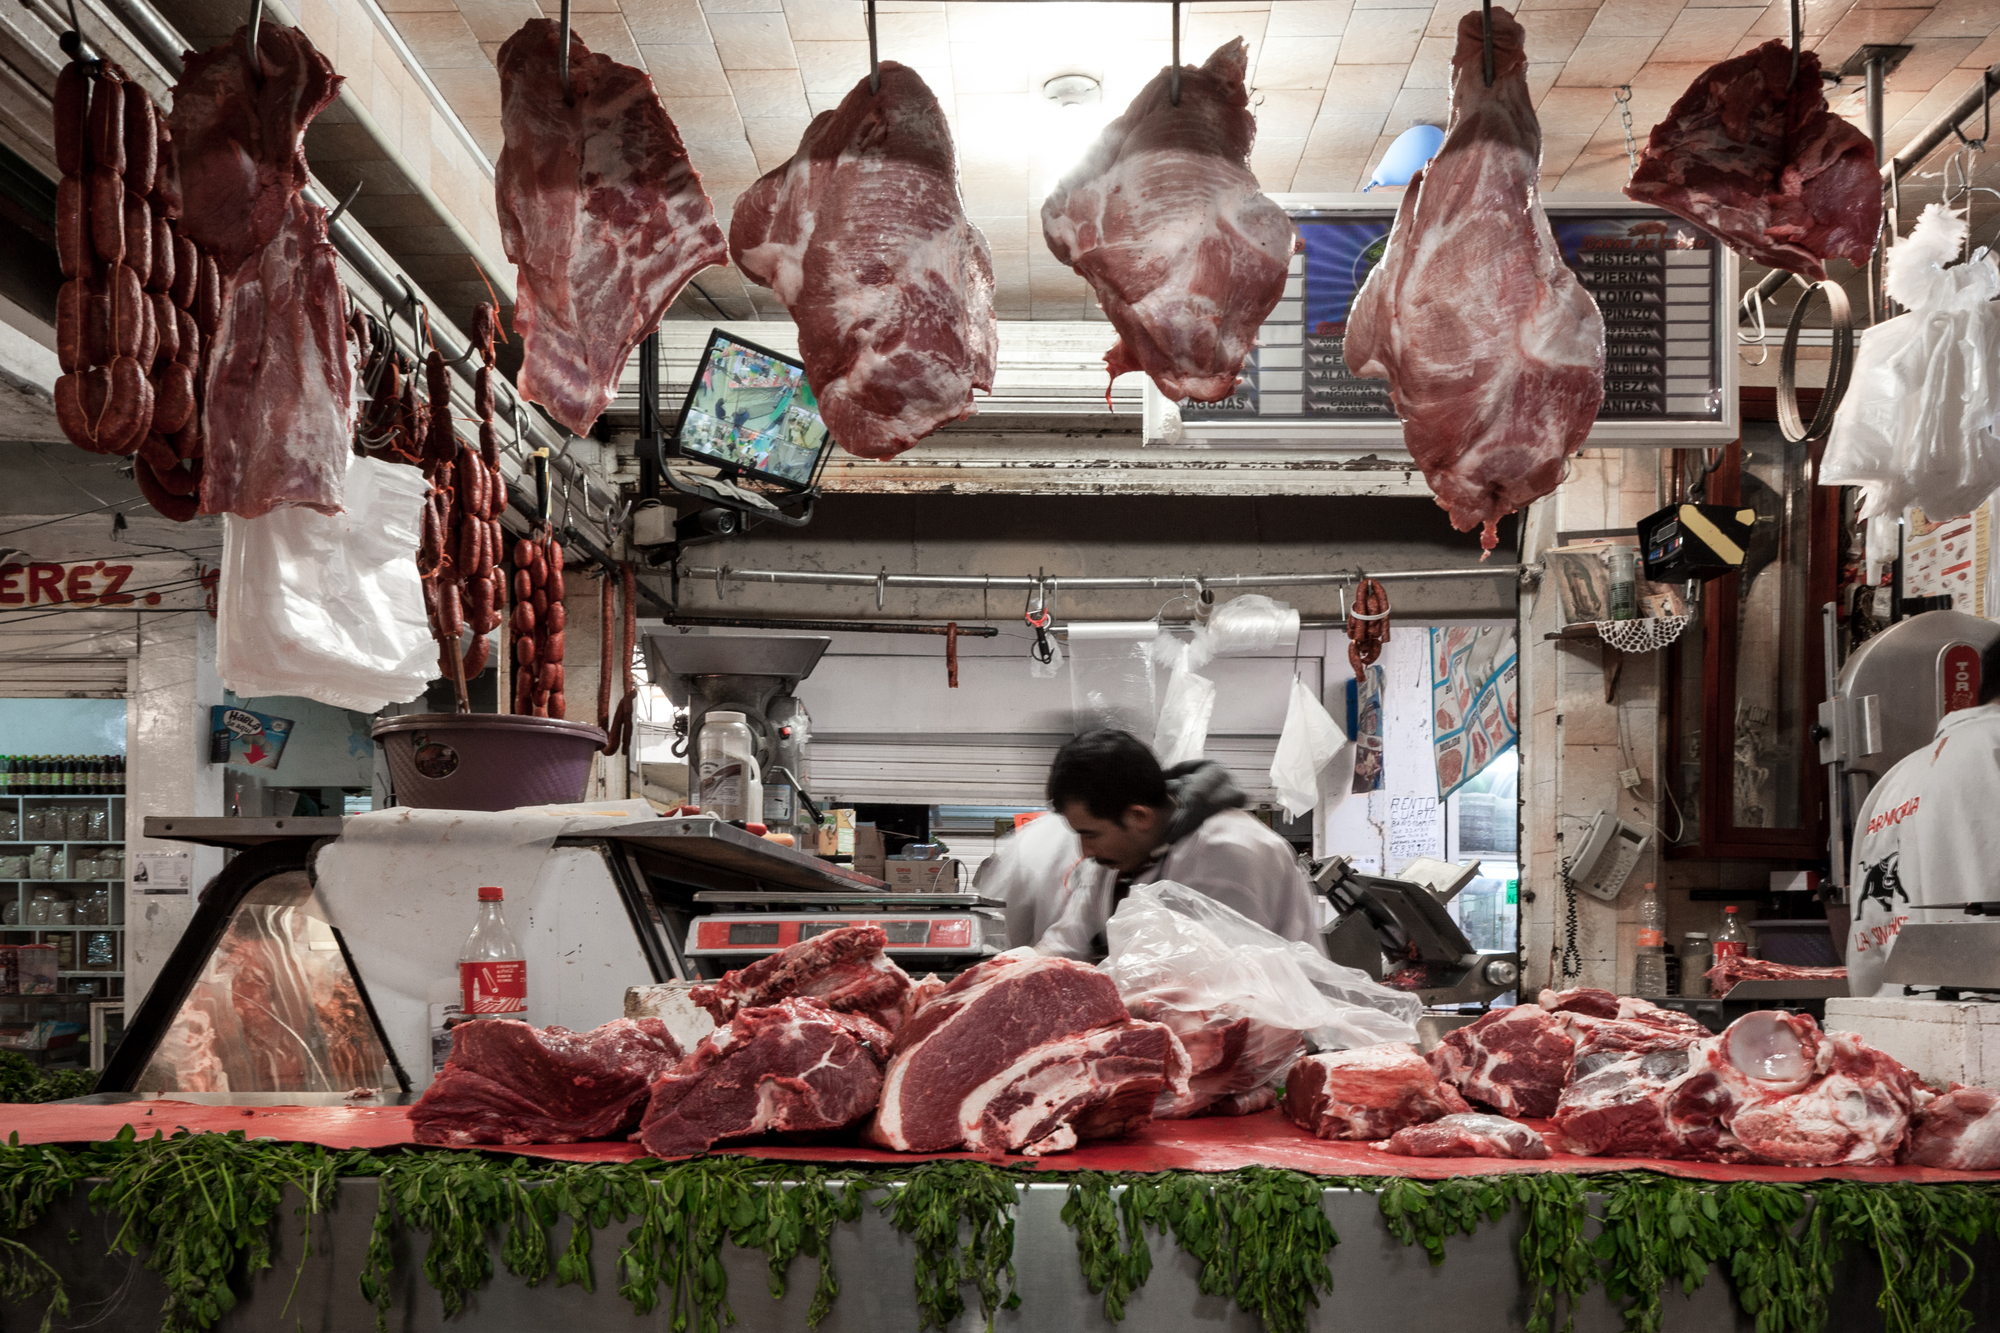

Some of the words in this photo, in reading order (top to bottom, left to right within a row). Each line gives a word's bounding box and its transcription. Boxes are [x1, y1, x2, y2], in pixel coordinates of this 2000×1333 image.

[1593, 253, 1648, 266] BISTECK
[1593, 272, 1649, 284] PIERNA
[1597, 291, 1644, 303] LOMO
[1602, 309, 1651, 320] SPINAZO
[1604, 364, 1653, 375] PALDILLA
[1603, 382, 1650, 393] ABEZA
[1186, 396, 1245, 410] AGUJAS
[1600, 401, 1653, 412] ANITAS
[1391, 810, 1436, 820] CUARTO
